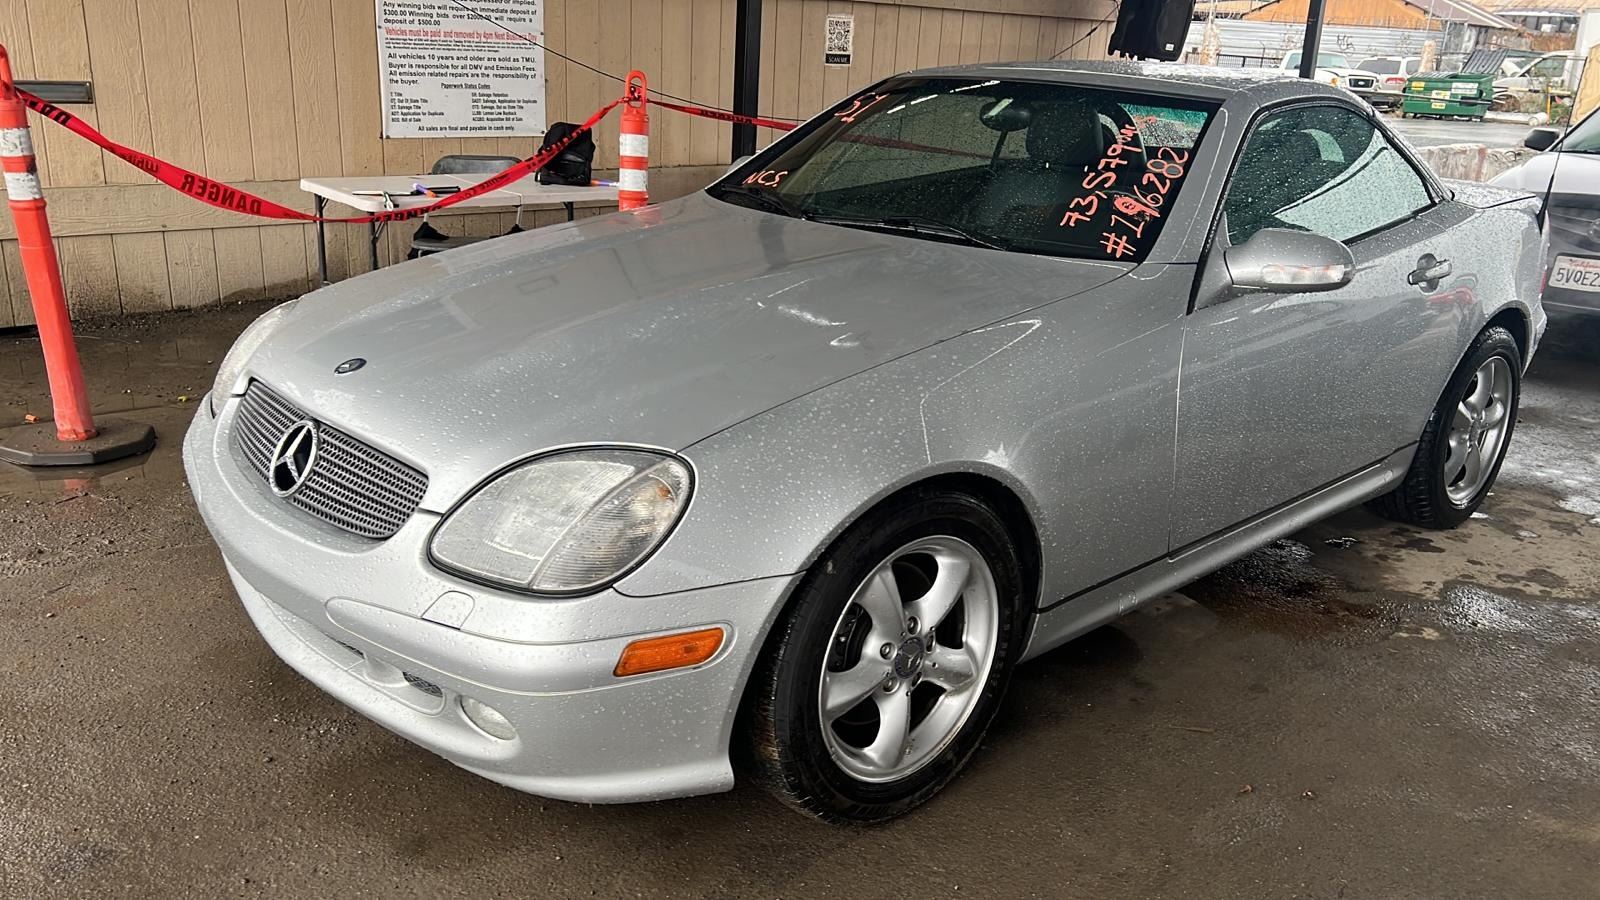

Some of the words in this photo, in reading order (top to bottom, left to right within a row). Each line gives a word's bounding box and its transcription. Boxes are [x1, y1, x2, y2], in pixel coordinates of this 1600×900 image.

[383, 1, 395, 9] Any
[396, 2, 421, 10] winning
[479, 6, 508, 14] immediate
[509, 8, 530, 16] deposit
[407, 10, 434, 19] Winning
[384, 27, 407, 36] Vehicles
[408, 28, 421, 37] must
[422, 29, 429, 37] be
[430, 29, 441, 39] paid
[443, 30, 453, 39] and
[453, 31, 475, 39] removed
[476, 30, 482, 41] by
[483, 30, 493, 41] 4pm
[494, 32, 505, 41] Next
[388, 62, 407, 70] Buyer
[414, 63, 450, 71] responsible
